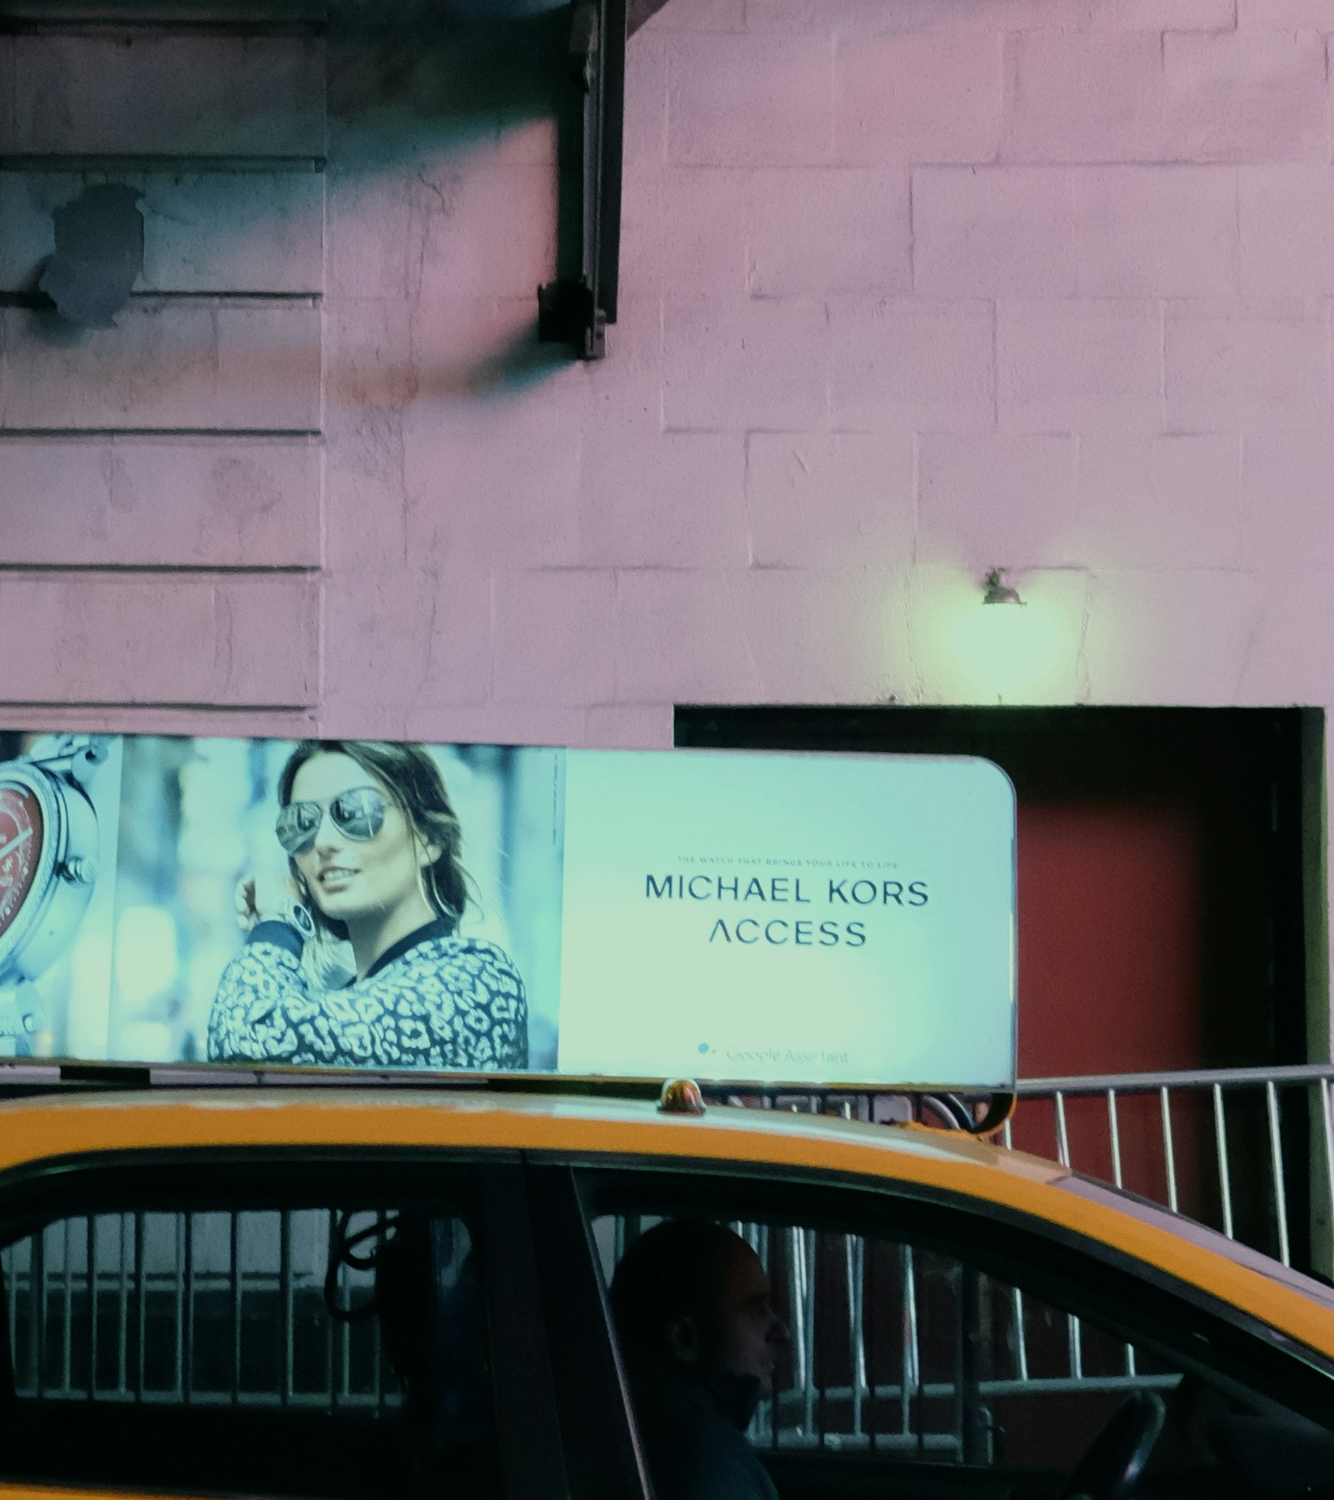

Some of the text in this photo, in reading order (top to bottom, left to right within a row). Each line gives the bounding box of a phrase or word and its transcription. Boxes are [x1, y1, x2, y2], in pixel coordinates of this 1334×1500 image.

[645, 873, 929, 907] MICHAEL KORS
[708, 918, 867, 947] ACCESS
